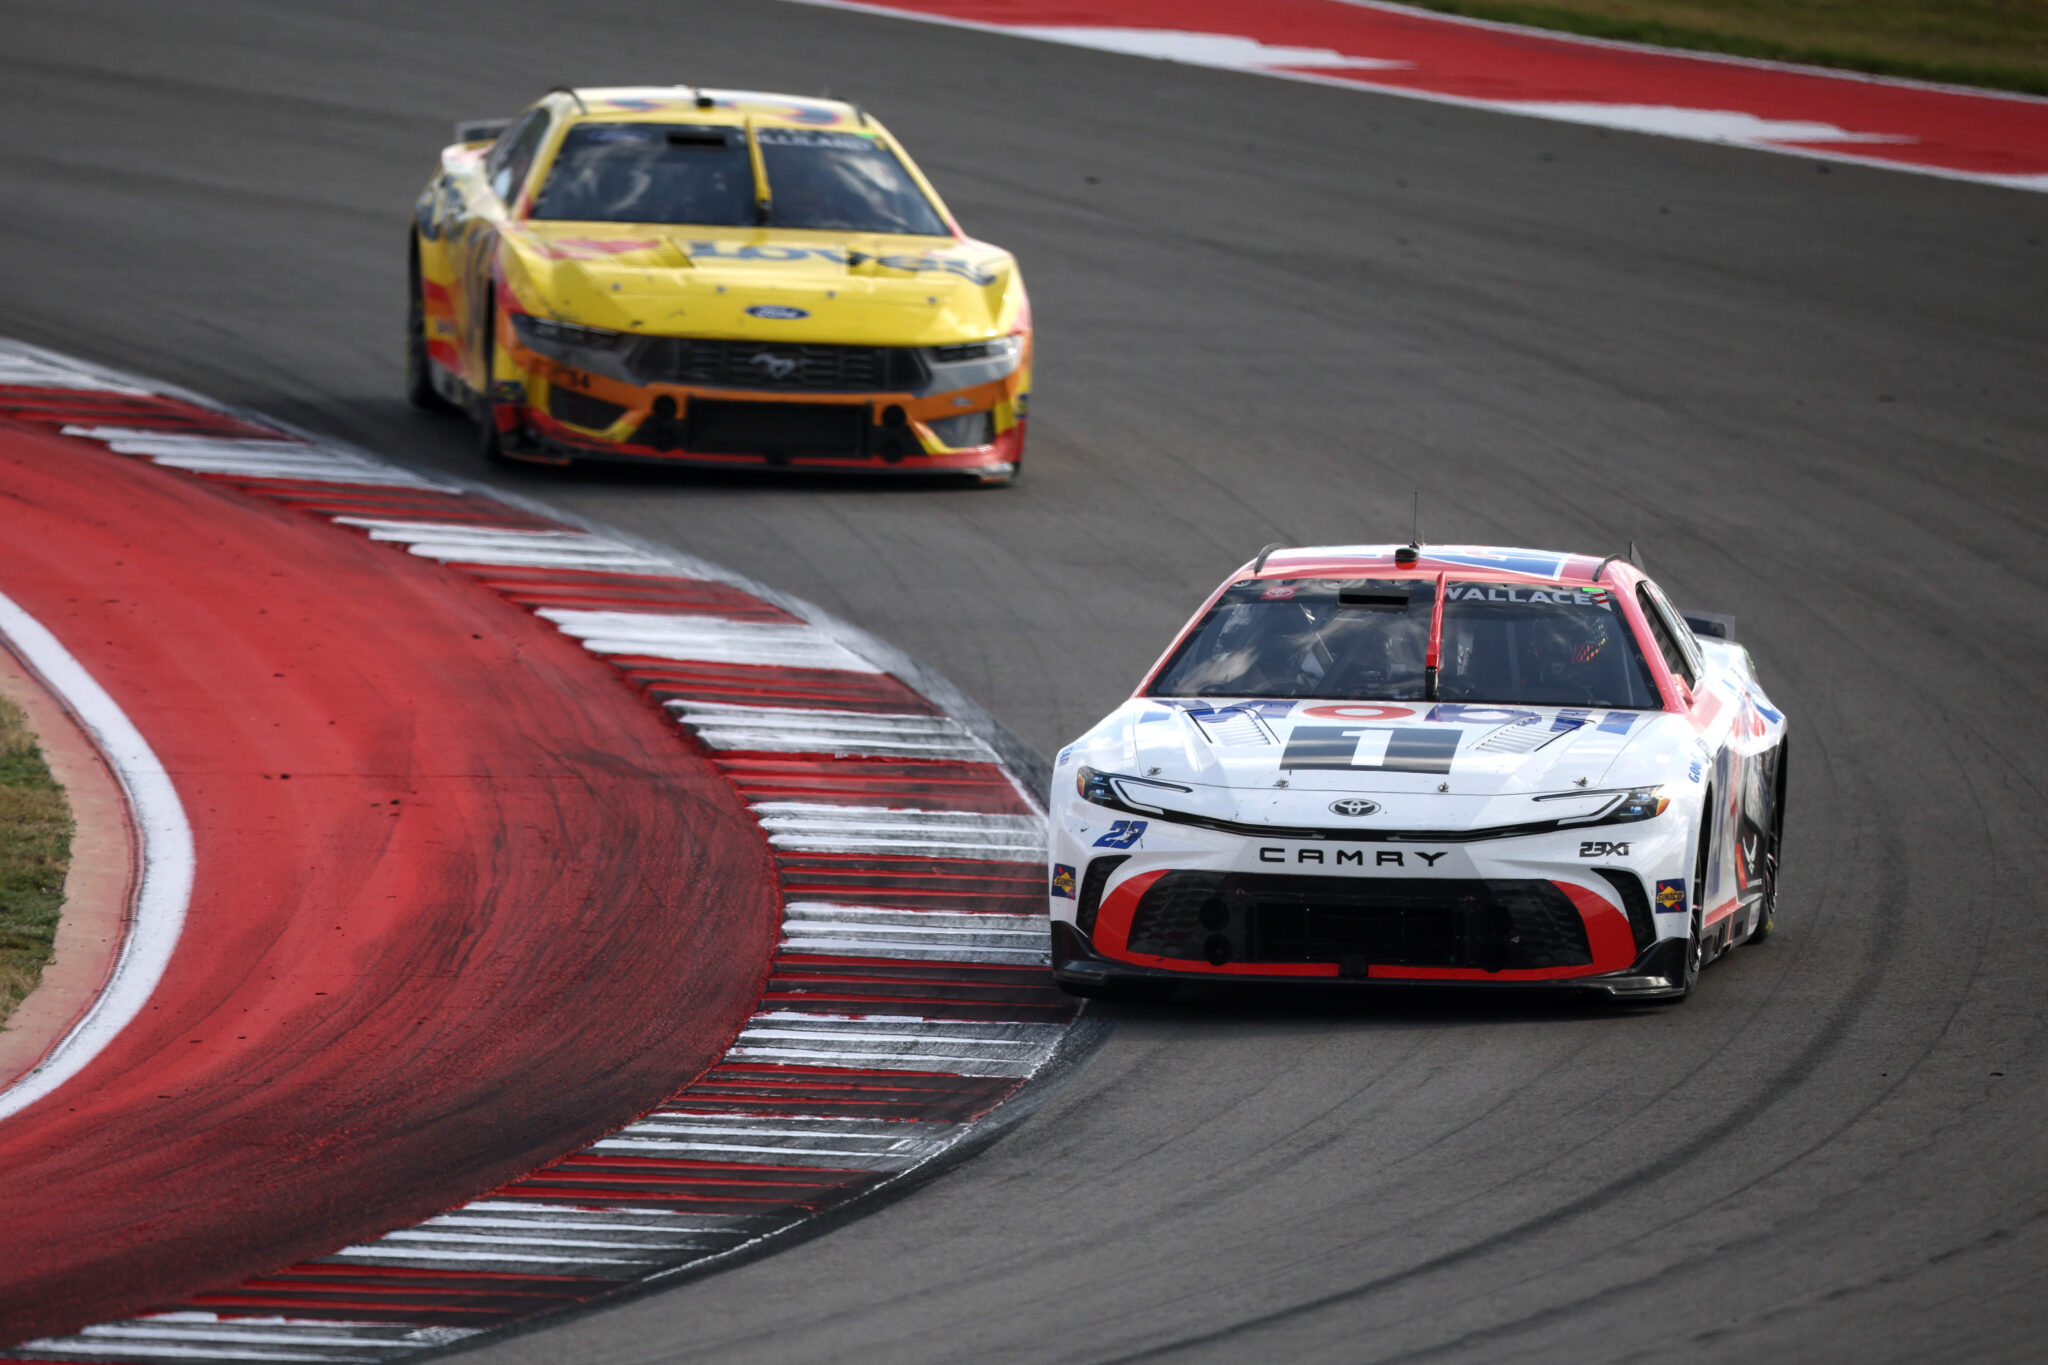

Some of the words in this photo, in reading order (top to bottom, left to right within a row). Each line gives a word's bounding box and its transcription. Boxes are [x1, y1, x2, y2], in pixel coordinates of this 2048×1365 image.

[1434, 587, 1593, 605] WALLACE
[1341, 729, 1394, 766] 1
[1259, 847, 1448, 867] CAMRY
